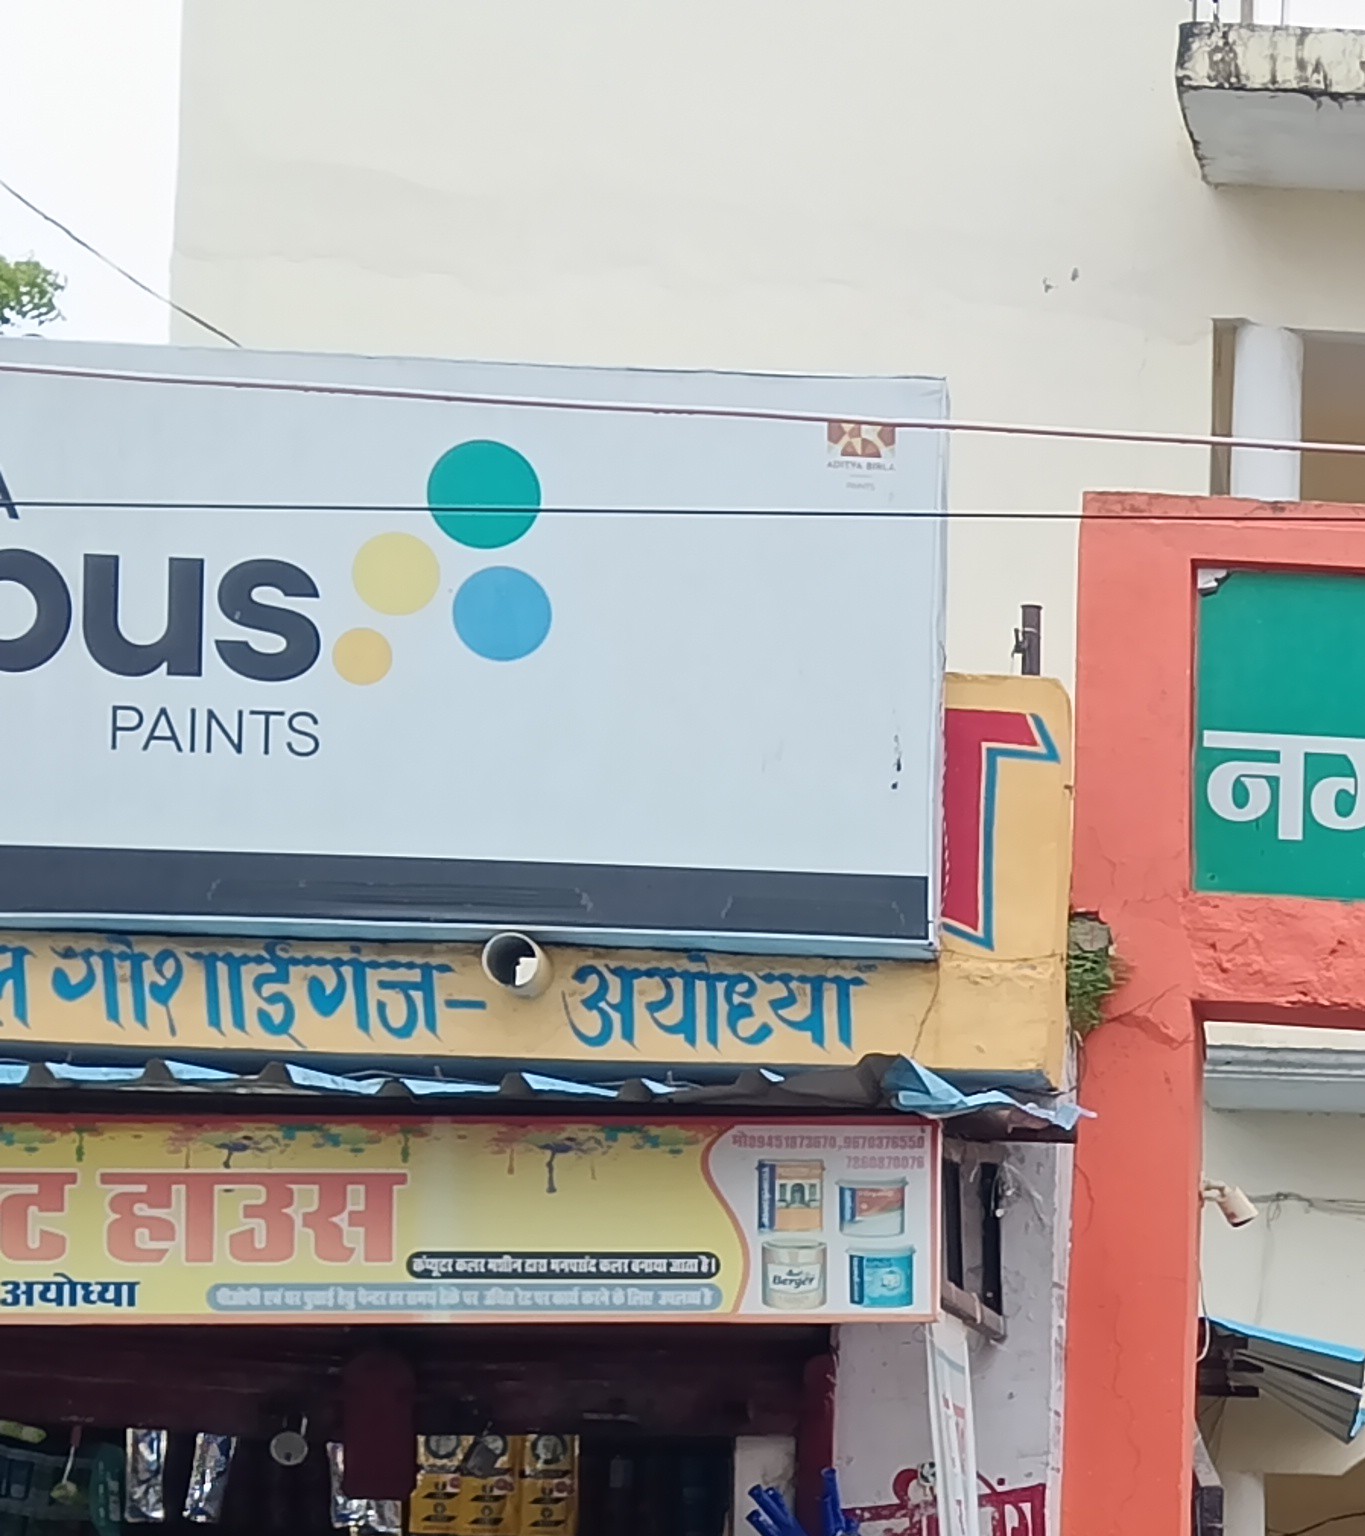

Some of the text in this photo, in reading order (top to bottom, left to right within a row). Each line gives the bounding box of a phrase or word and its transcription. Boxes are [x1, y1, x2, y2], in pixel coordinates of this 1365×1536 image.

[827, 461, 896, 471] ADITYA BIRLA
[111, 705, 320, 757] PAINTS
[564, 944, 877, 1052] अयोध्या
[99, 1171, 409, 1264] हाउस
[0, 1272, 140, 1307] अयोध्या
